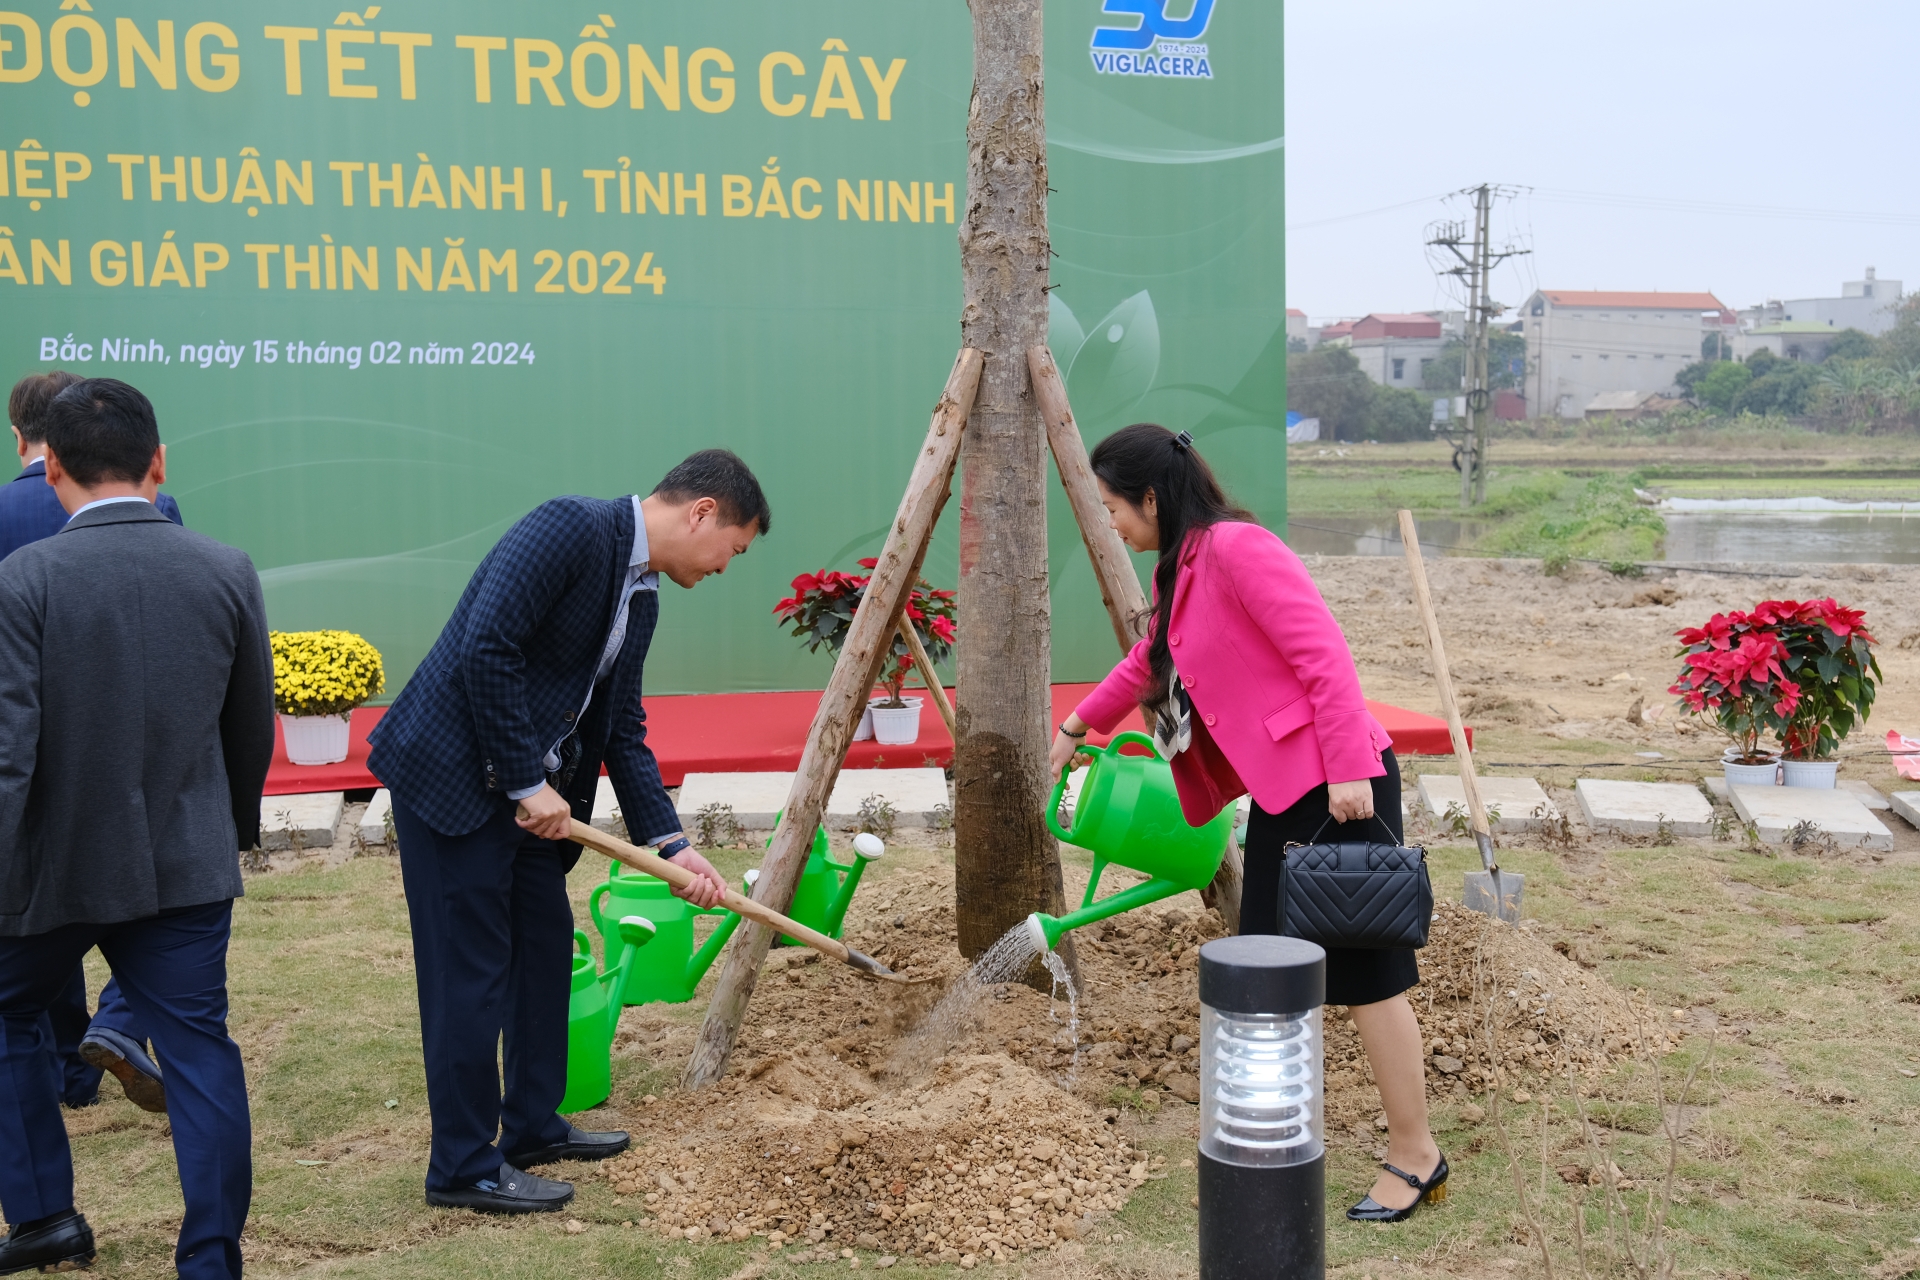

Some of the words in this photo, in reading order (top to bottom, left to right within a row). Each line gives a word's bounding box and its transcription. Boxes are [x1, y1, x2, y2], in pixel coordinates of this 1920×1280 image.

[0, 0, 240, 108] ĐỘNG
[264, 6, 434, 101] TẾT
[455, 14, 736, 116] TRỒNG
[759, 38, 907, 121] CÂY
[1092, 53, 1211, 77] VIGLACERA
[1158, 44, 1179, 53] 1974
[1185, 46, 1206, 54] 2024
[0, 139, 92, 212] IỆP
[107, 147, 318, 218] THUẬN
[329, 153, 525, 211] THÀNH
[541, 168, 568, 217] I,
[583, 156, 707, 216] TỈNH
[722, 155, 822, 220] BẮC
[837, 179, 955, 224] NINH
[0, 226, 72, 285] ÂN
[90, 230, 230, 289] GIÁP
[244, 234, 379, 291] THÌN
[396, 237, 518, 293] NĂM
[533, 249, 667, 295] 2024
[40, 337, 93, 362] Bắc
[101, 337, 171, 365] Ninh,
[179, 339, 245, 369] ngày
[252, 339, 279, 364] 15
[285, 339, 363, 370] tháng
[369, 341, 402, 365] 02
[408, 341, 464, 365] năm
[470, 341, 536, 365] 2024
